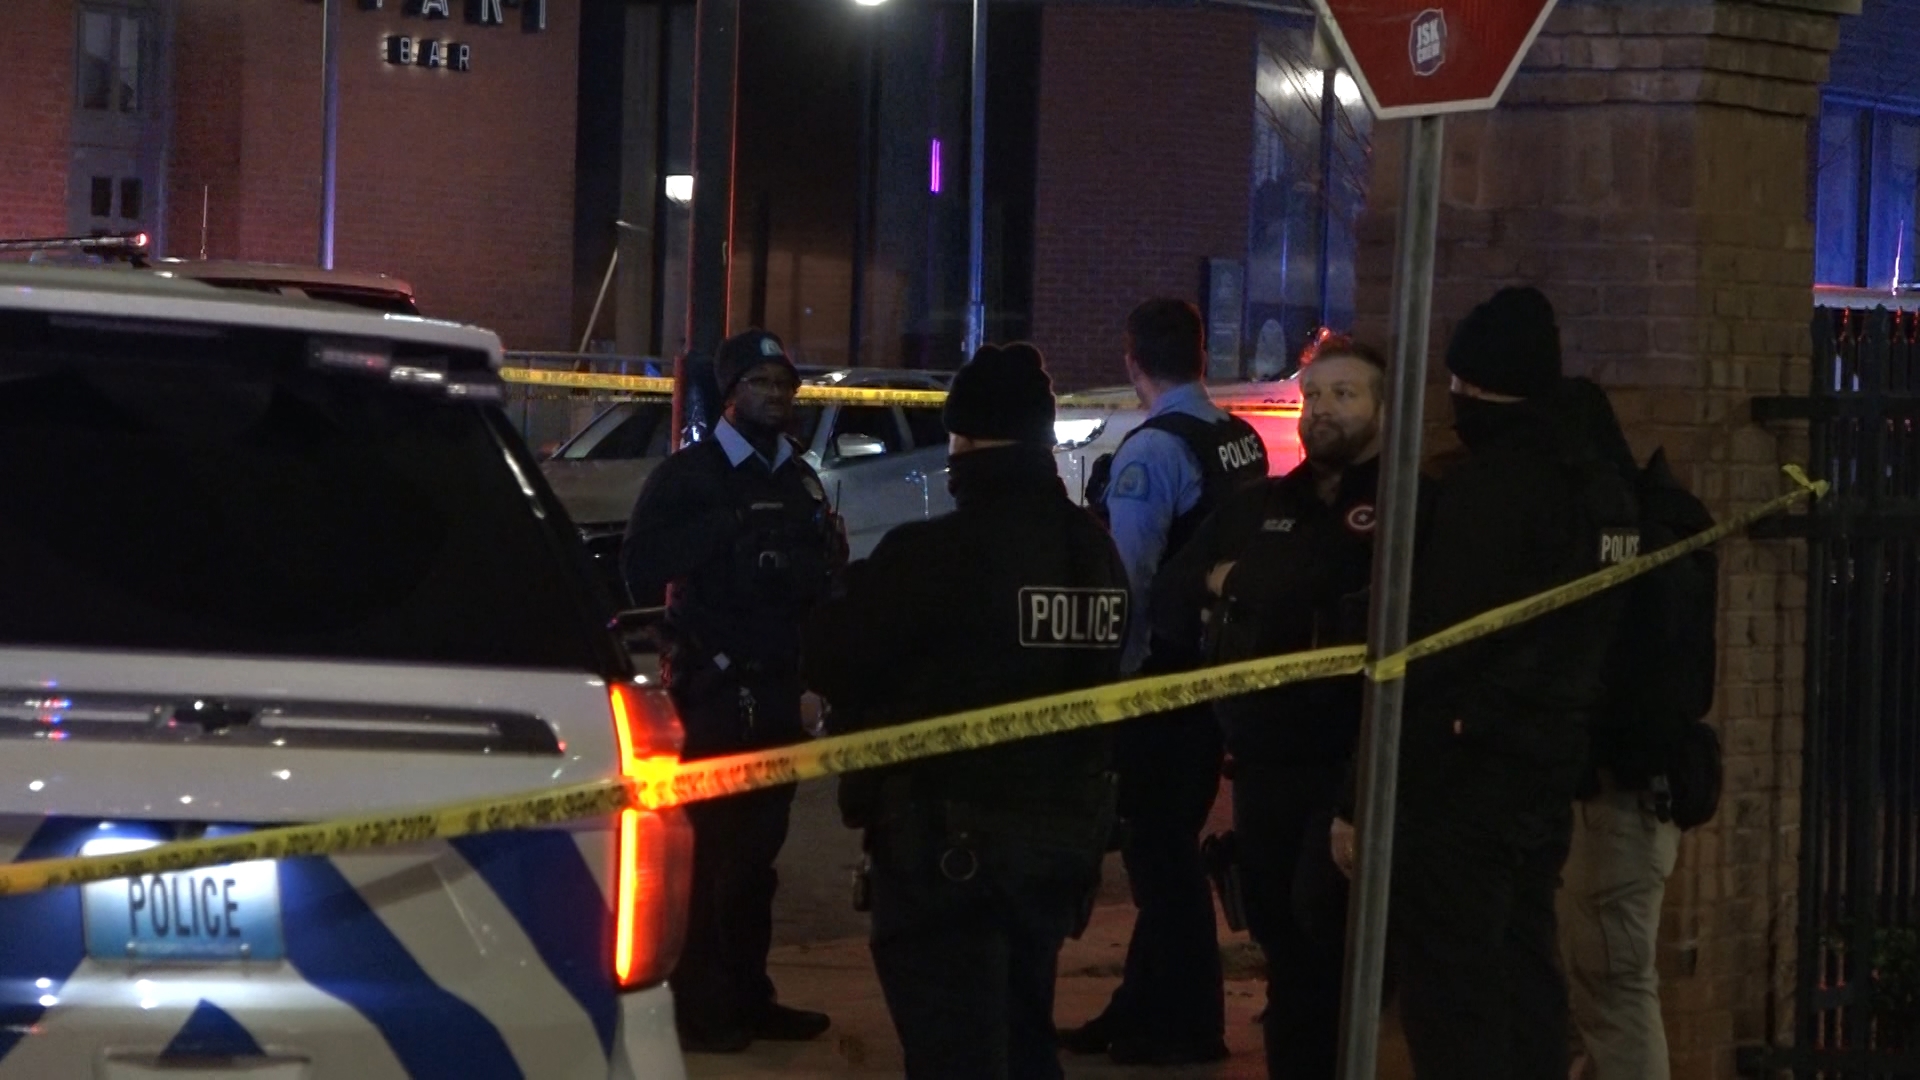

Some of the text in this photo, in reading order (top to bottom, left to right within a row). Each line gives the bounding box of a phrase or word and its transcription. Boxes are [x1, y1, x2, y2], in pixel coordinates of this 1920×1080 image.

[398, 37, 470, 71] BAR
[1218, 434, 1264, 472] POLICE
[1030, 594, 1122, 641] POLICE
[129, 874, 241, 938] POLICE
